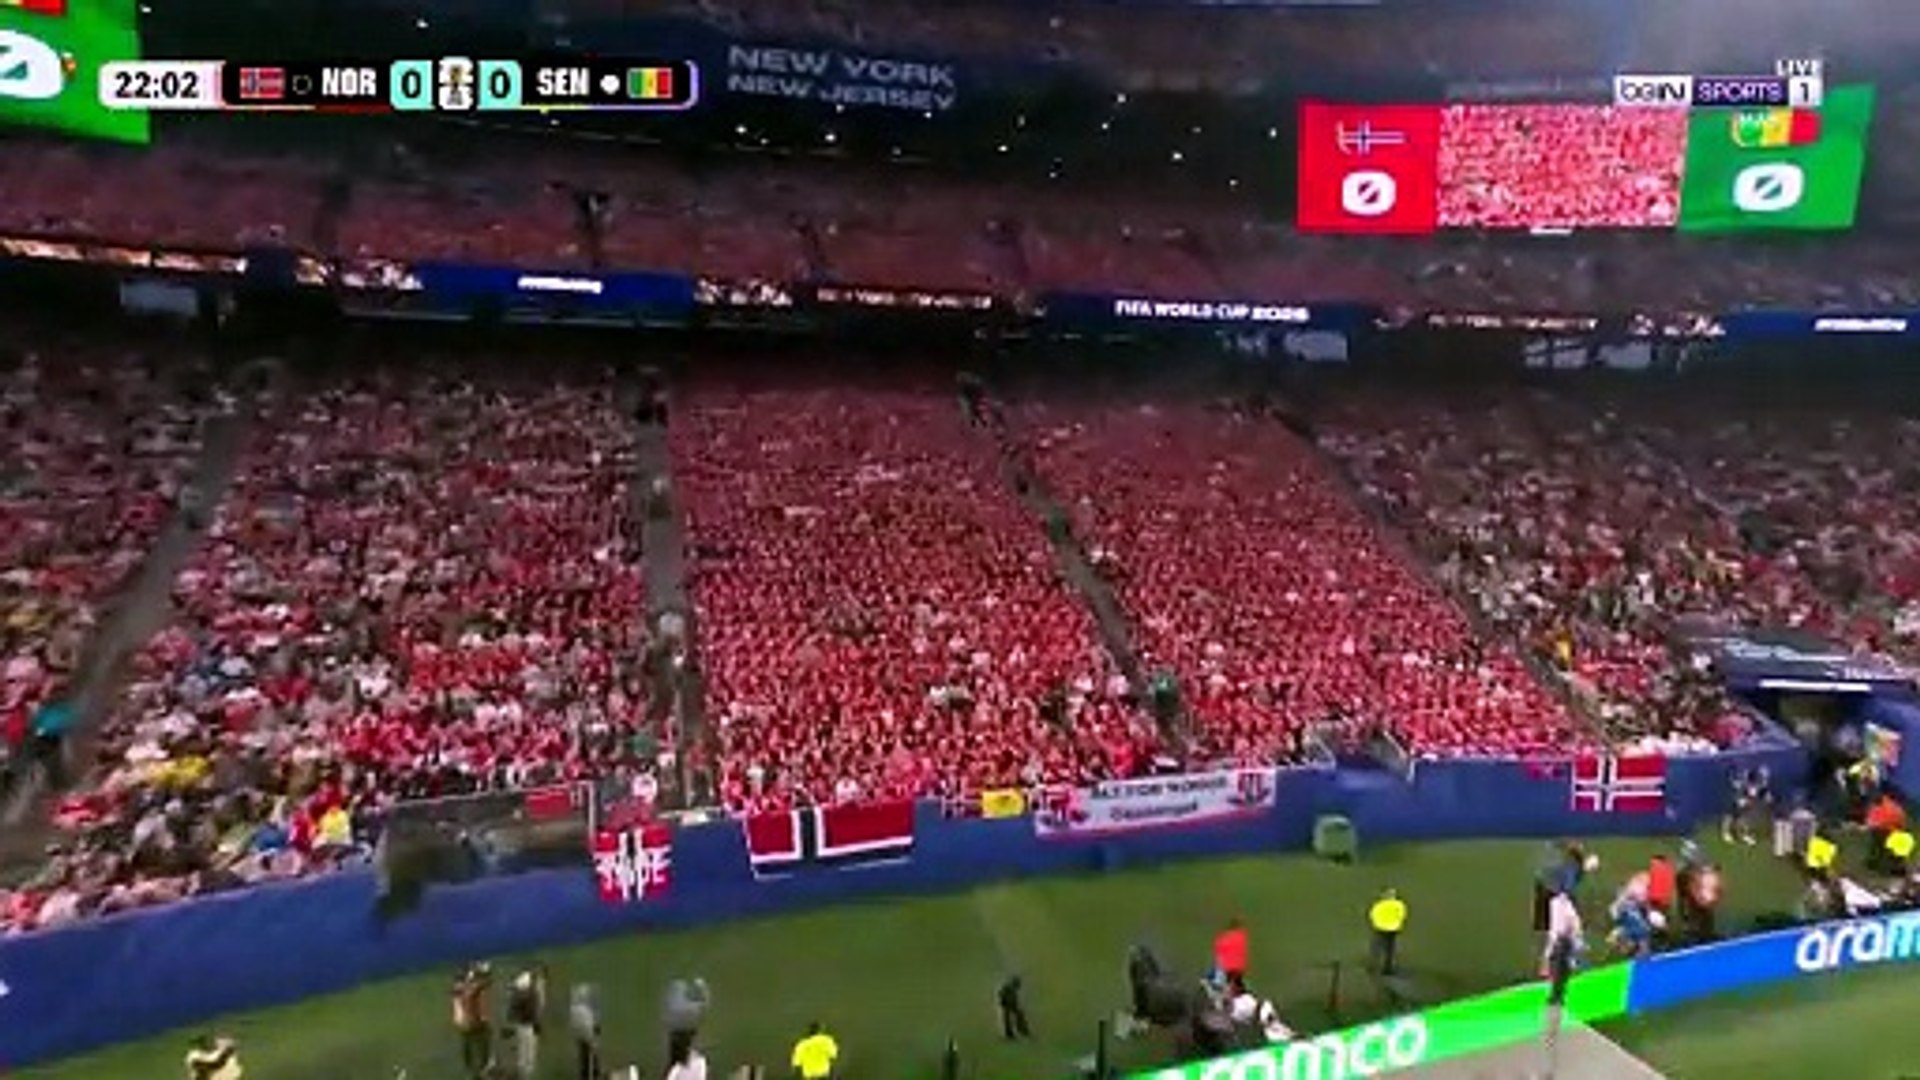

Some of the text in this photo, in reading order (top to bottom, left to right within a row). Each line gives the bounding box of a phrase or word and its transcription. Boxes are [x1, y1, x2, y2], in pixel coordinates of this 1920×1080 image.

[728, 45, 955, 88] NEW YORK
[727, 74, 957, 109] NEW JERSEY
[1157, 1016, 1427, 1080] amco
